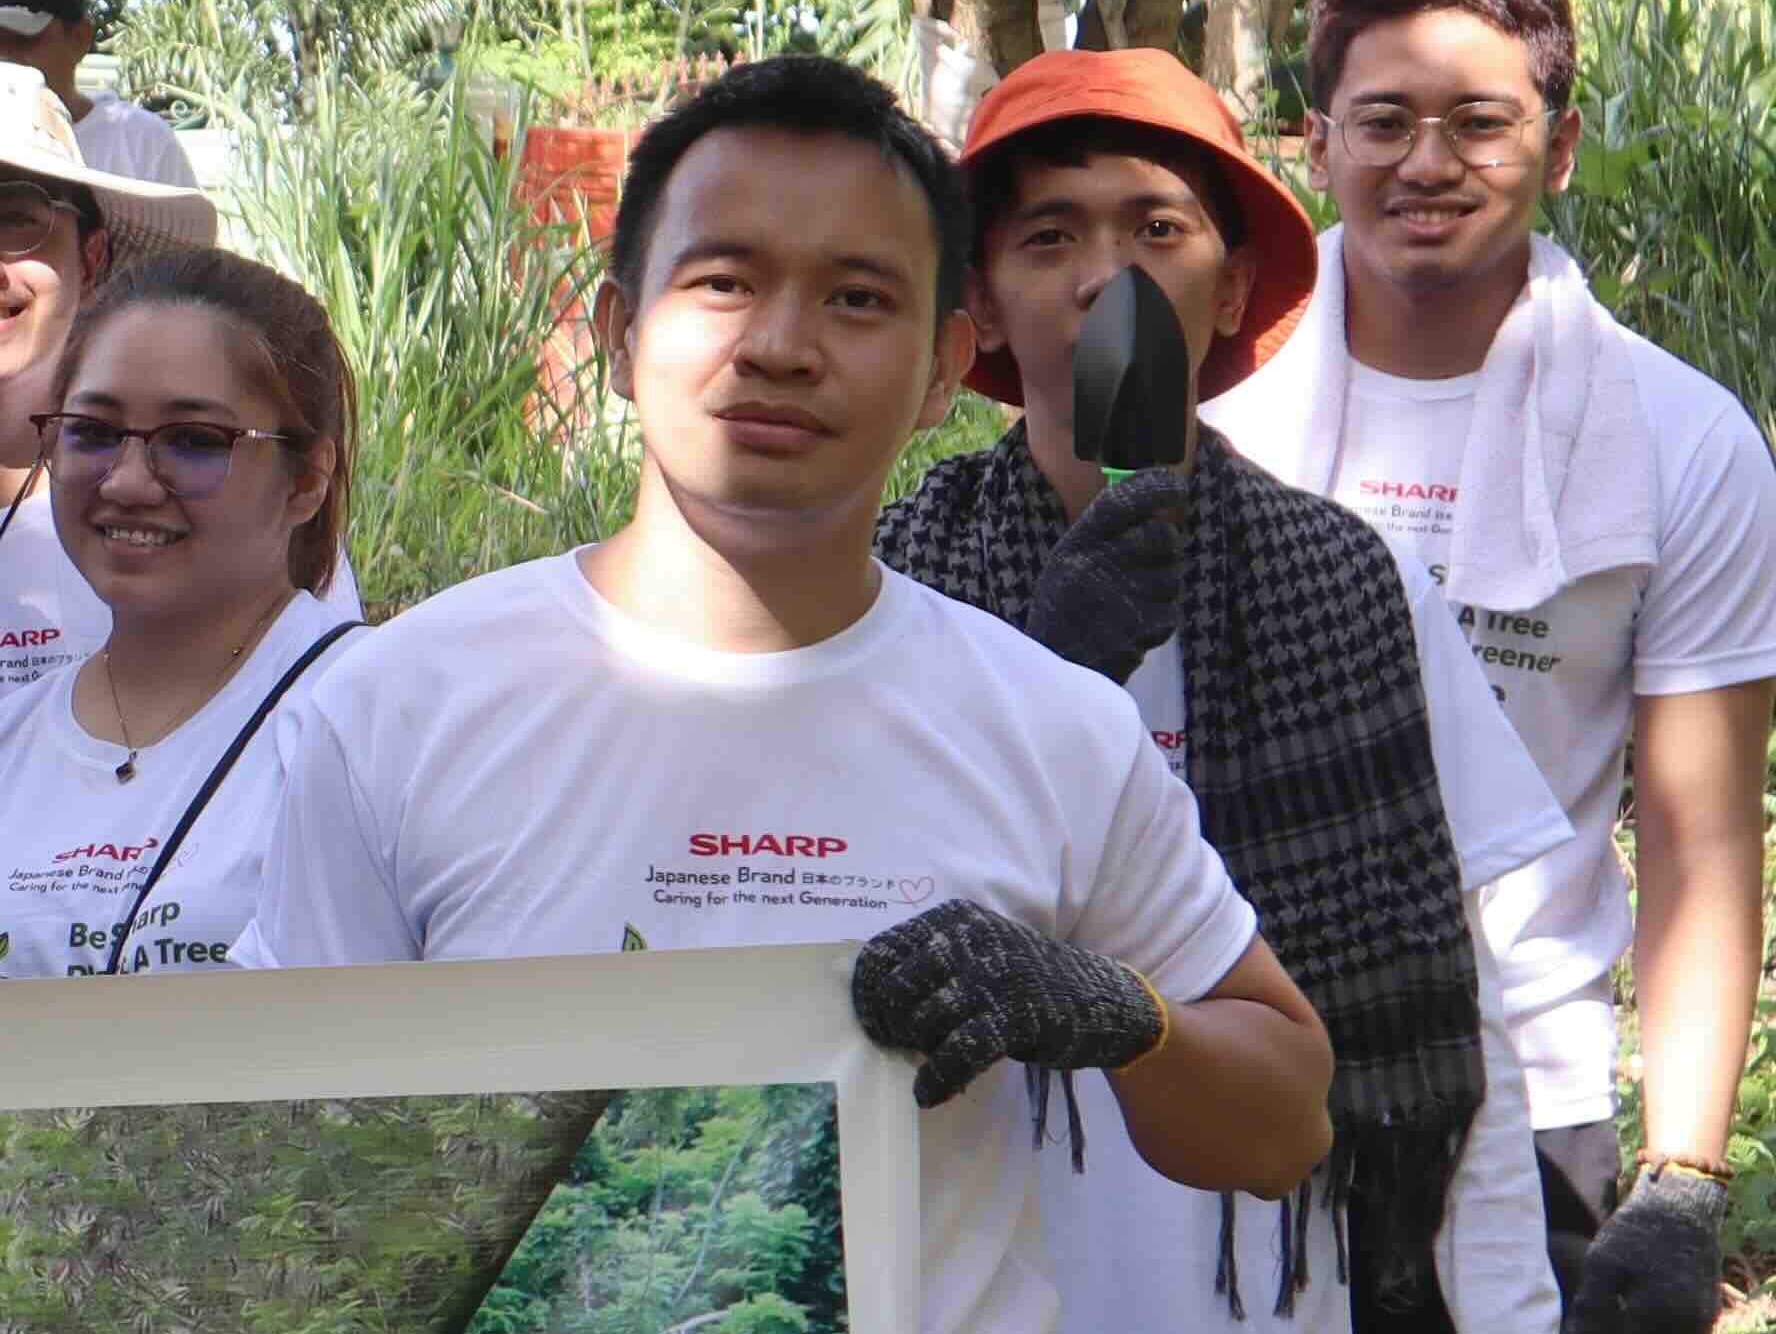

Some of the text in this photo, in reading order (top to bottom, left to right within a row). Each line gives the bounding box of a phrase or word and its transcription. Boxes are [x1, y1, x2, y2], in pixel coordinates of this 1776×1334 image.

[1470, 643, 1563, 675] reener
[689, 834, 848, 858] SHARP
[78, 865, 123, 881] Brand
[645, 865, 731, 886] Japanese
[738, 867, 795, 885] Brand
[653, 889, 887, 910] Caring for the next Generation
[69, 923, 106, 950] Be
[154, 937, 228, 965] Tree
